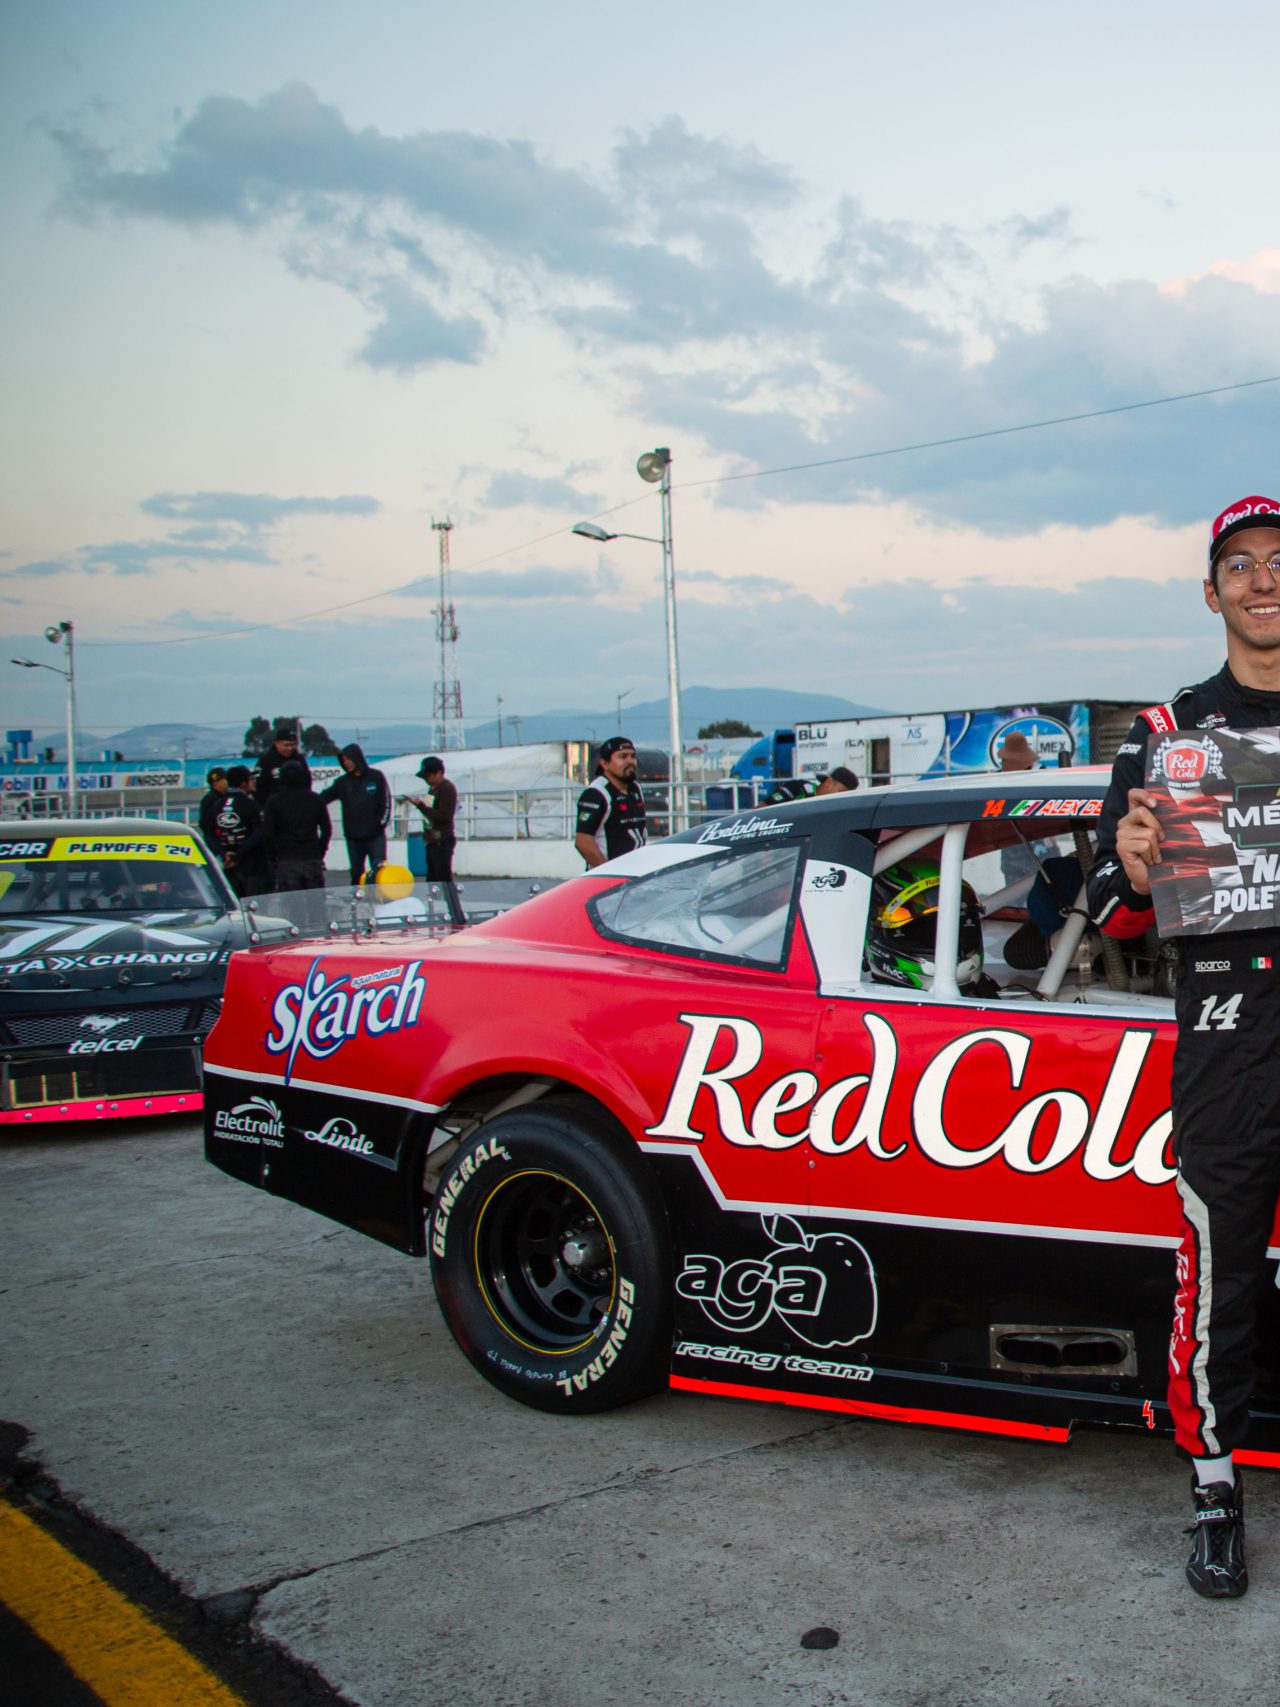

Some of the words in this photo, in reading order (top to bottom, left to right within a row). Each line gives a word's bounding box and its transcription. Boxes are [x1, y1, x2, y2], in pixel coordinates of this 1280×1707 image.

[1170, 752, 1199, 769] Red
[136, 773, 181, 787] NASCAR
[981, 798, 1007, 818] 14
[1034, 799, 1088, 817] ALEX
[67, 842, 158, 854] PLAYOFFS
[1212, 884, 1276, 915] POLE
[1195, 960, 1232, 972] sparco
[1193, 993, 1244, 1031] 14
[67, 1035, 145, 1055] telcel
[643, 1011, 909, 1160] Red
[214, 1110, 287, 1138] Electrolit
[304, 1117, 375, 1155] Linde
[432, 1136, 506, 1258] GENERAL
[675, 1255, 827, 1333] aga
[555, 1276, 636, 1397] GENERAL
[675, 1342, 784, 1372] racing
[784, 1353, 875, 1382] team
